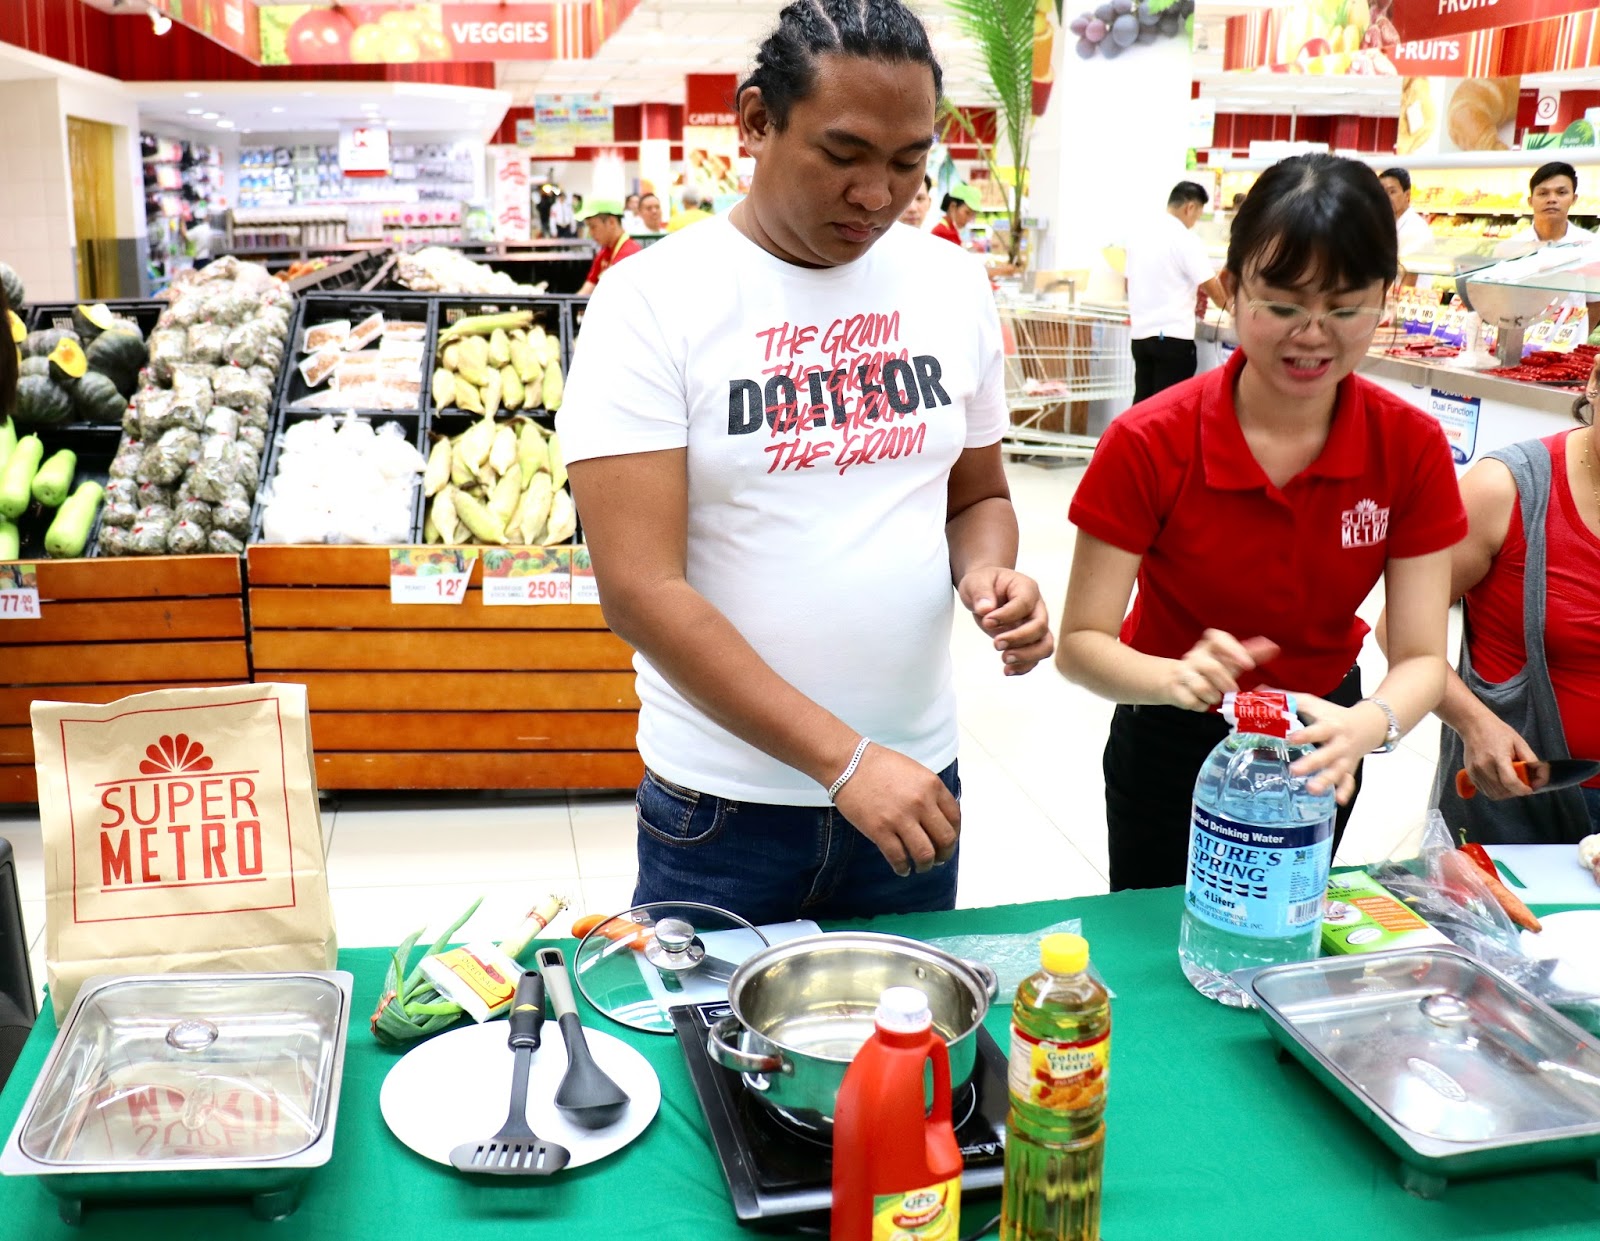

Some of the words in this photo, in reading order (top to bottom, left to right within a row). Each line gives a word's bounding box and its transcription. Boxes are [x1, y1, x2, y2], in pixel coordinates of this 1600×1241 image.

[451, 21, 549, 44] VEGGIES
[1395, 41, 1460, 61] FRUITS
[1543, 103, 1550, 113] 2
[1422, 310, 1434, 319] 185
[756, 322, 819, 361] THE
[820, 310, 900, 367] GRAM
[728, 375, 798, 436] DO
[808, 369, 847, 427] IT
[857, 354, 952, 420] FOR
[765, 400, 829, 438] THE
[1432, 401, 1446, 411] Dual
[1447, 404, 1474, 417] Function
[764, 438, 834, 474] THE
[834, 422, 926, 476] GRAM
[1341, 508, 1390, 528] SUPER
[1341, 521, 1389, 547] METRO
[528, 581, 557, 599] 250
[100, 777, 259, 829] SUPER
[1210, 821, 1250, 842] Drinking
[1252, 832, 1284, 843] Water
[100, 819, 264, 886] METRO
[1193, 830, 1283, 867] ATURE'S
[1192, 846, 1266, 882] SPRING
[1204, 890, 1210, 900] 4
[1211, 893, 1235, 909] Liters
[1047, 1051, 1095, 1062] Golden
[1051, 1061, 1092, 1071] Fiesta
